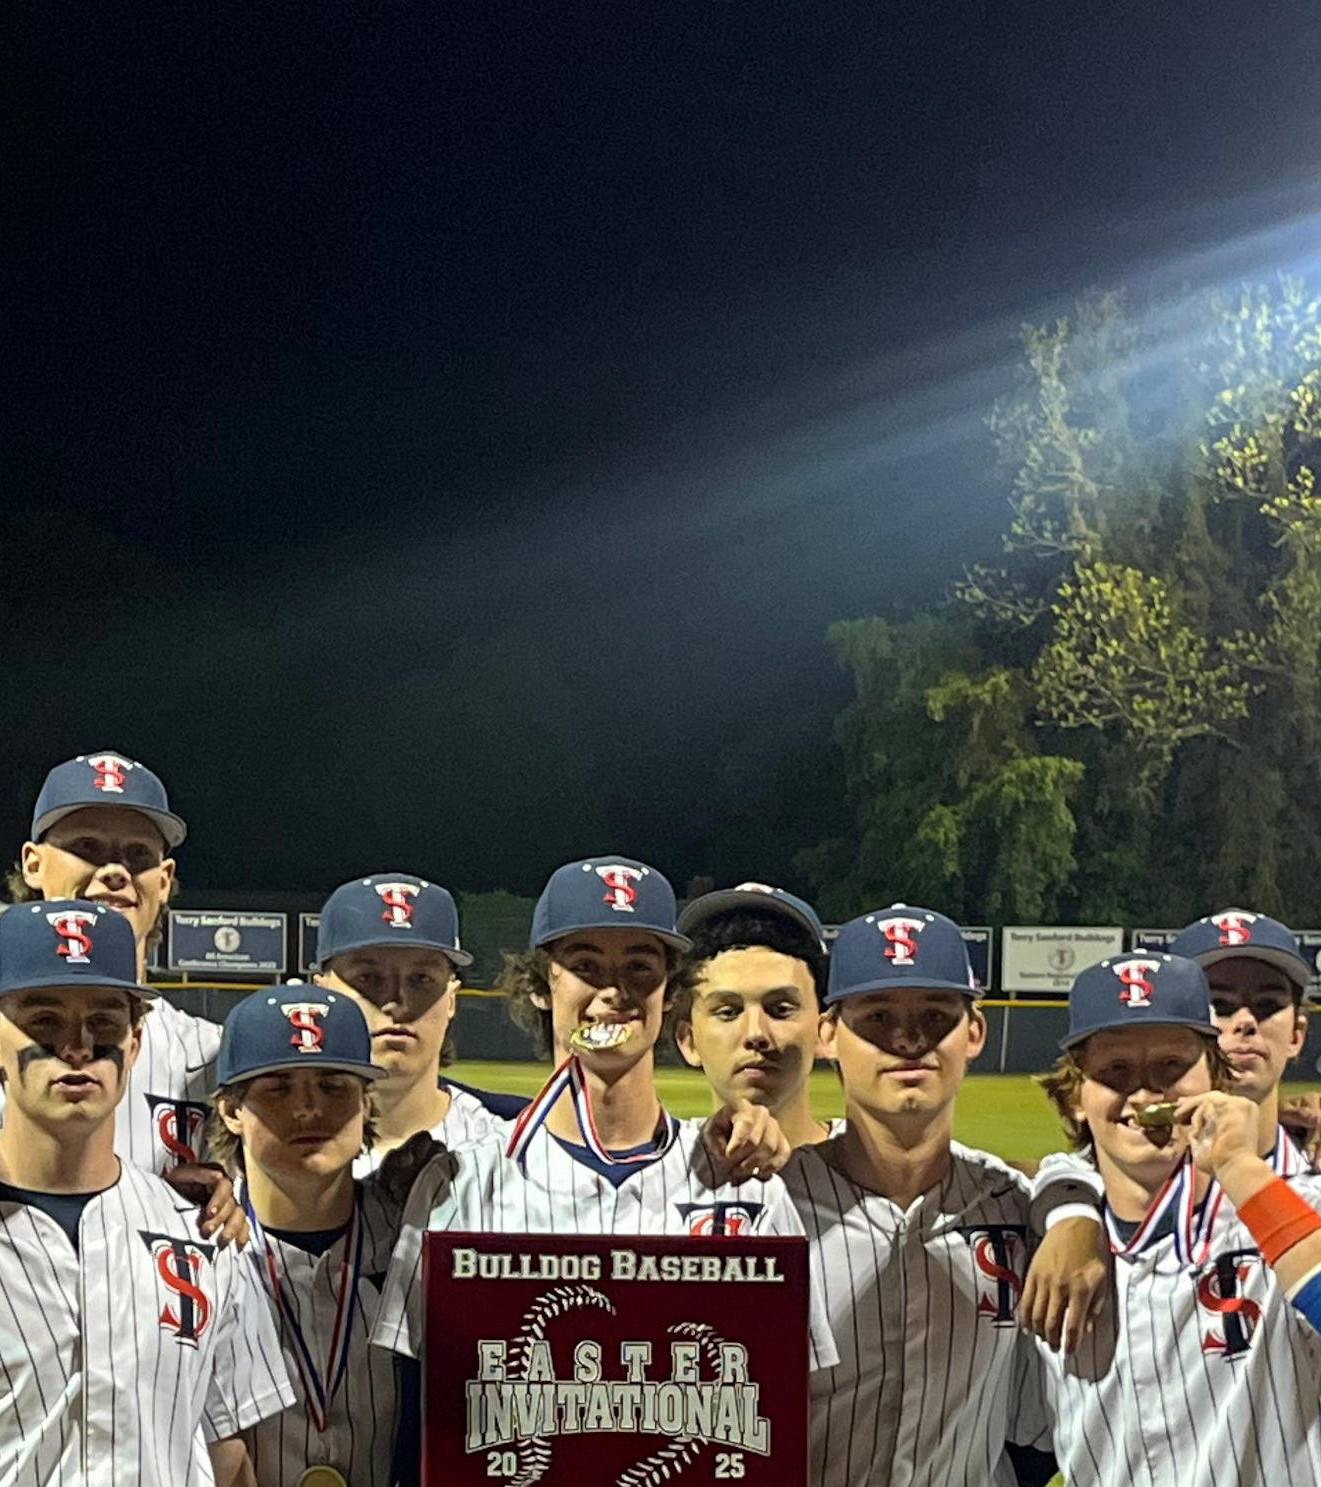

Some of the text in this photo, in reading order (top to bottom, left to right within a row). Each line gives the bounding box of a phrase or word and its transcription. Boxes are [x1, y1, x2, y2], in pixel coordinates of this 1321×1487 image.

[477, 1339, 750, 1384] EASTER
[465, 1379, 771, 1457] INVITATIONAL
[487, 1451, 517, 1477] 20
[715, 1453, 745, 1478] 25
